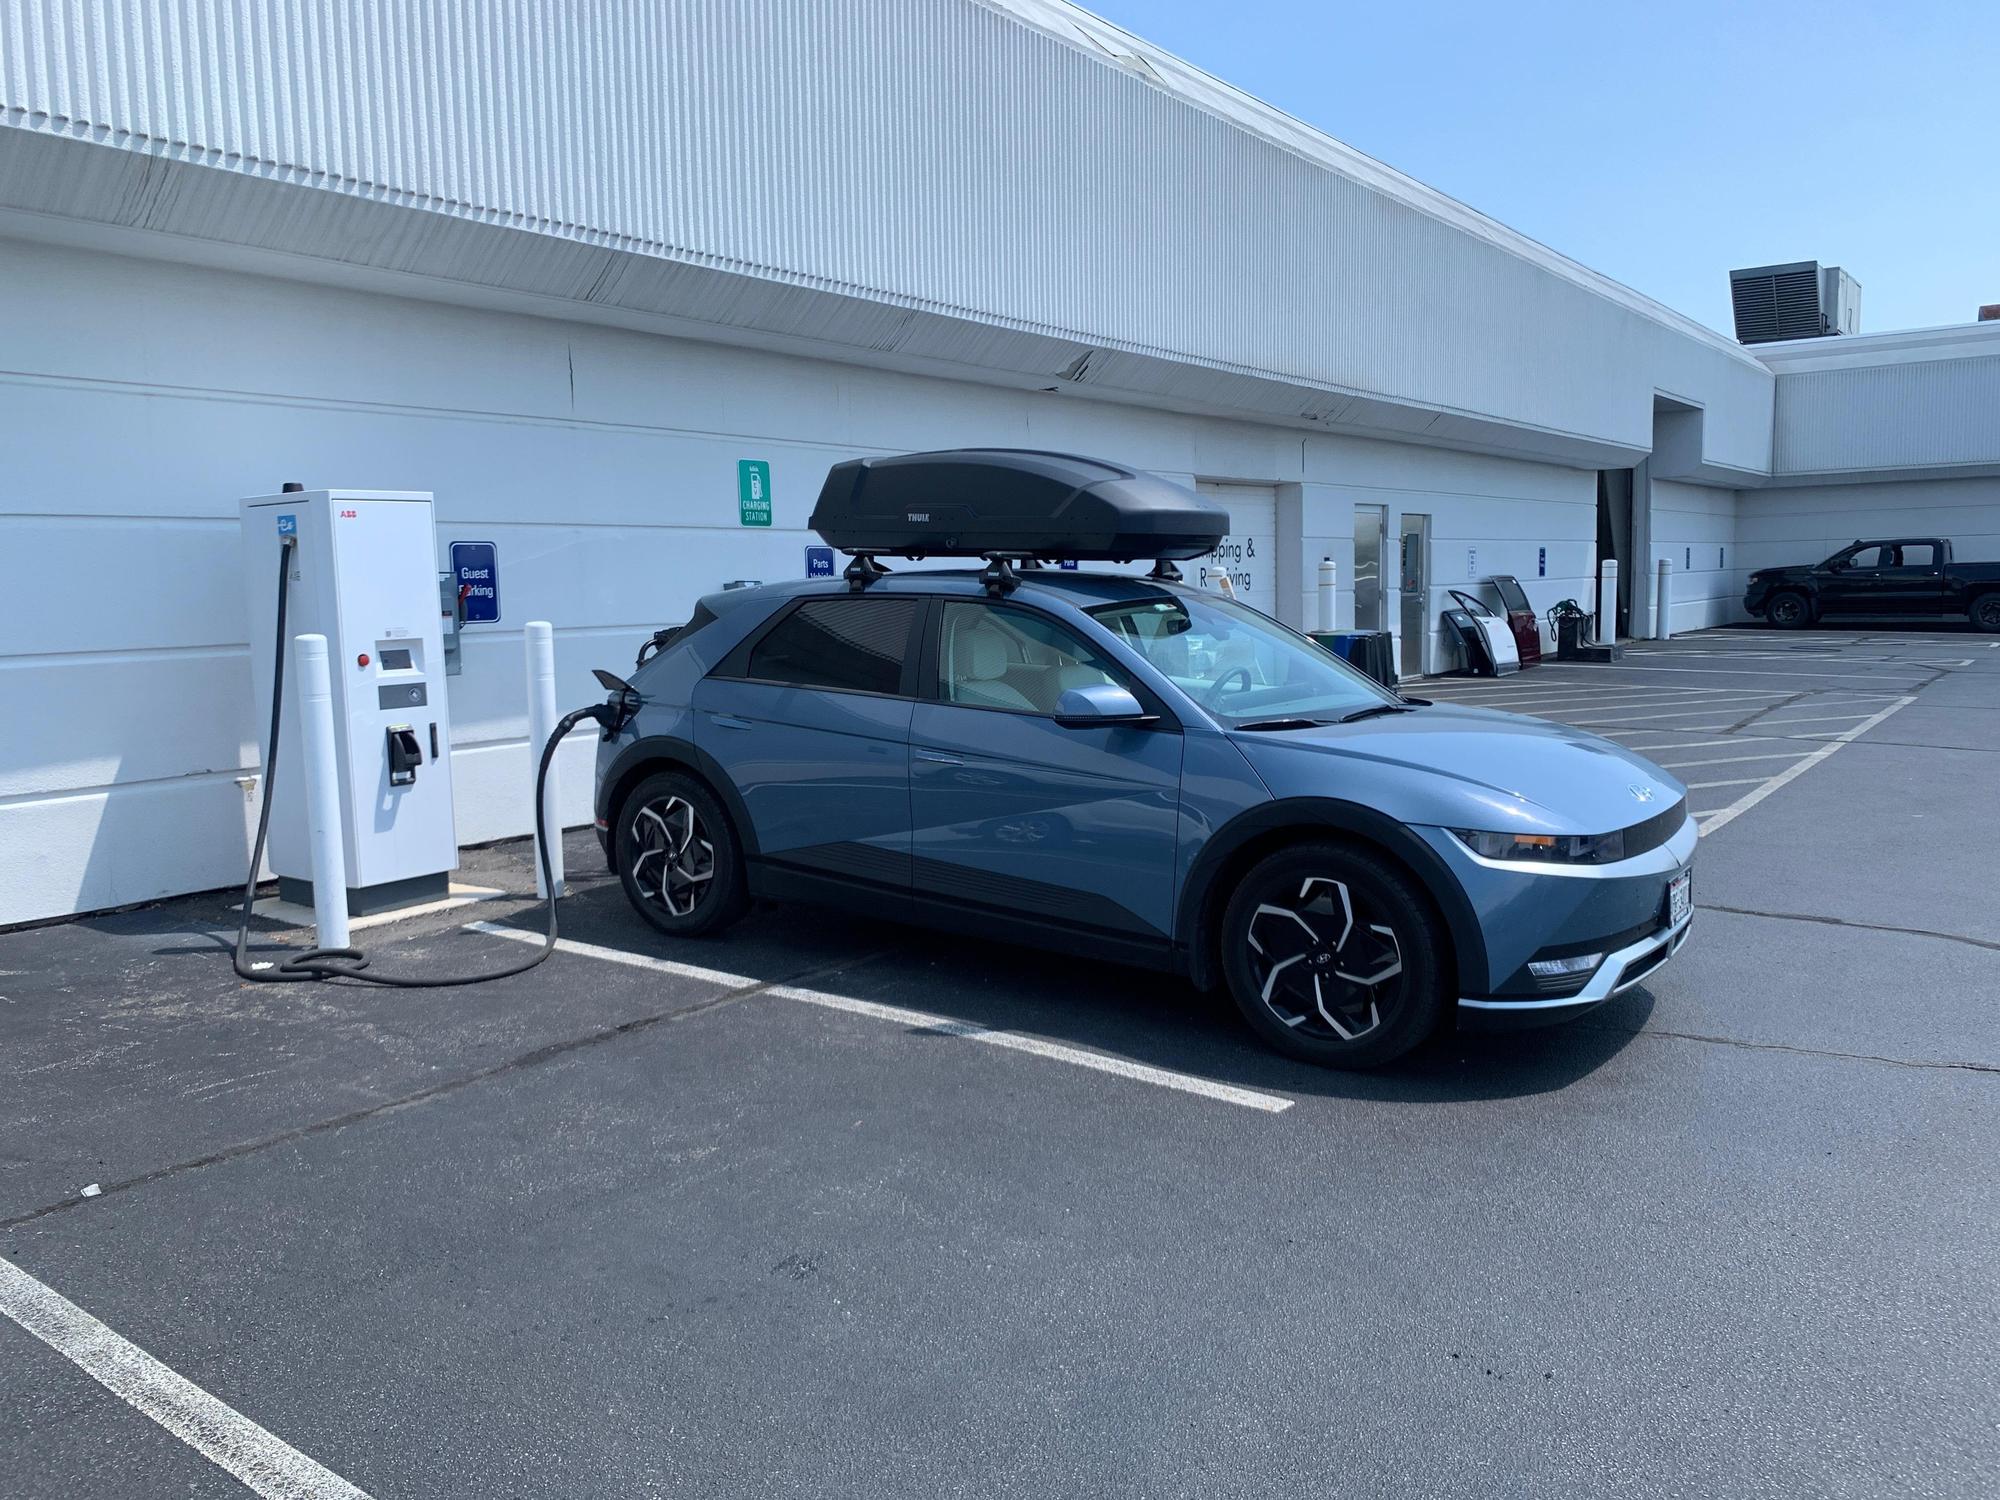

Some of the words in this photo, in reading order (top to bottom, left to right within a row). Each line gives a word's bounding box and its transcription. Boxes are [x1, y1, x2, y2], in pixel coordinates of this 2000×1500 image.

[742, 500, 770, 511] CHARGING
[340, 510, 357, 518] ABB
[745, 511, 768, 521] STATION
[907, 512, 930, 522] THULE
[1201, 538, 1241, 564] pping
[1246, 537, 1255, 558] &
[812, 558, 829, 569] Parts
[461, 567, 489, 579] Guest
[1200, 567, 1251, 591] Rving
